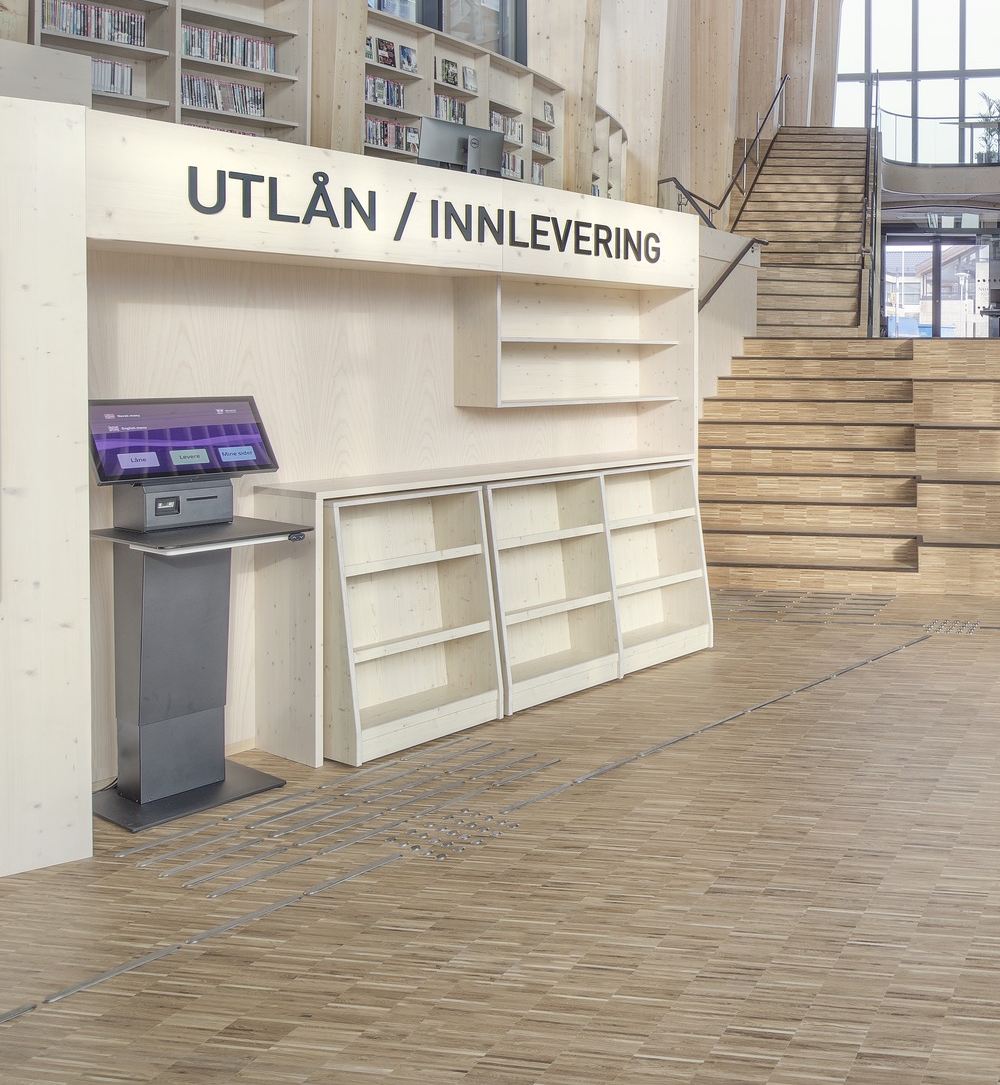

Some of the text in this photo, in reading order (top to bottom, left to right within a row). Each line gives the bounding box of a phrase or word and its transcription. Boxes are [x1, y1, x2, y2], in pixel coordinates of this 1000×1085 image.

[187, 165, 660, 264] UTLÅN / INNLEVERING
